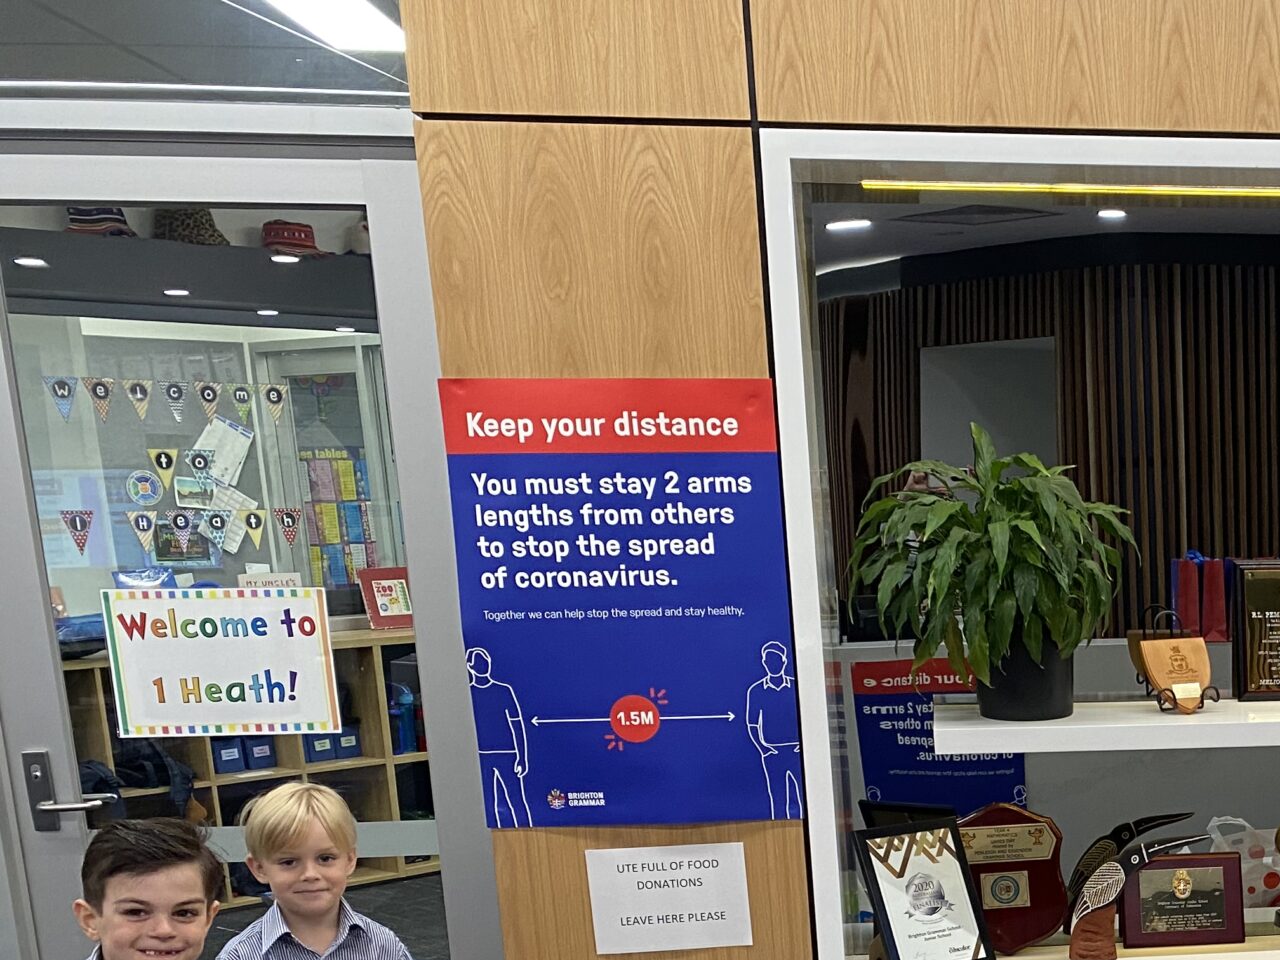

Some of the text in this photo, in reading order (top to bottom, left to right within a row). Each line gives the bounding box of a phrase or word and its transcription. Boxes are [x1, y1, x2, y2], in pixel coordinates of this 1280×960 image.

[465, 411, 739, 443] Keep your distance
[470, 471, 752, 500] You must stay 2 arms
[474, 501, 735, 533] lengths from others
[477, 532, 716, 563] to stop the spread
[480, 564, 679, 589] of coronavirus.
[483, 604, 746, 622] Together we can help stop the spread and stay healthy.
[116, 607, 316, 641] Welcome to
[152, 668, 298, 704] 1 Heath!
[616, 710, 654, 726] 1.5M
[568, 792, 604, 800] BRIGHTON
[568, 798, 606, 807] GRAMMAR
[616, 858, 720, 874] UTE FULL OF FOOD
[636, 877, 704, 890] DONATIONS
[912, 880, 935, 893] 2020
[620, 910, 727, 927] LEAVE HERE PLEASE
